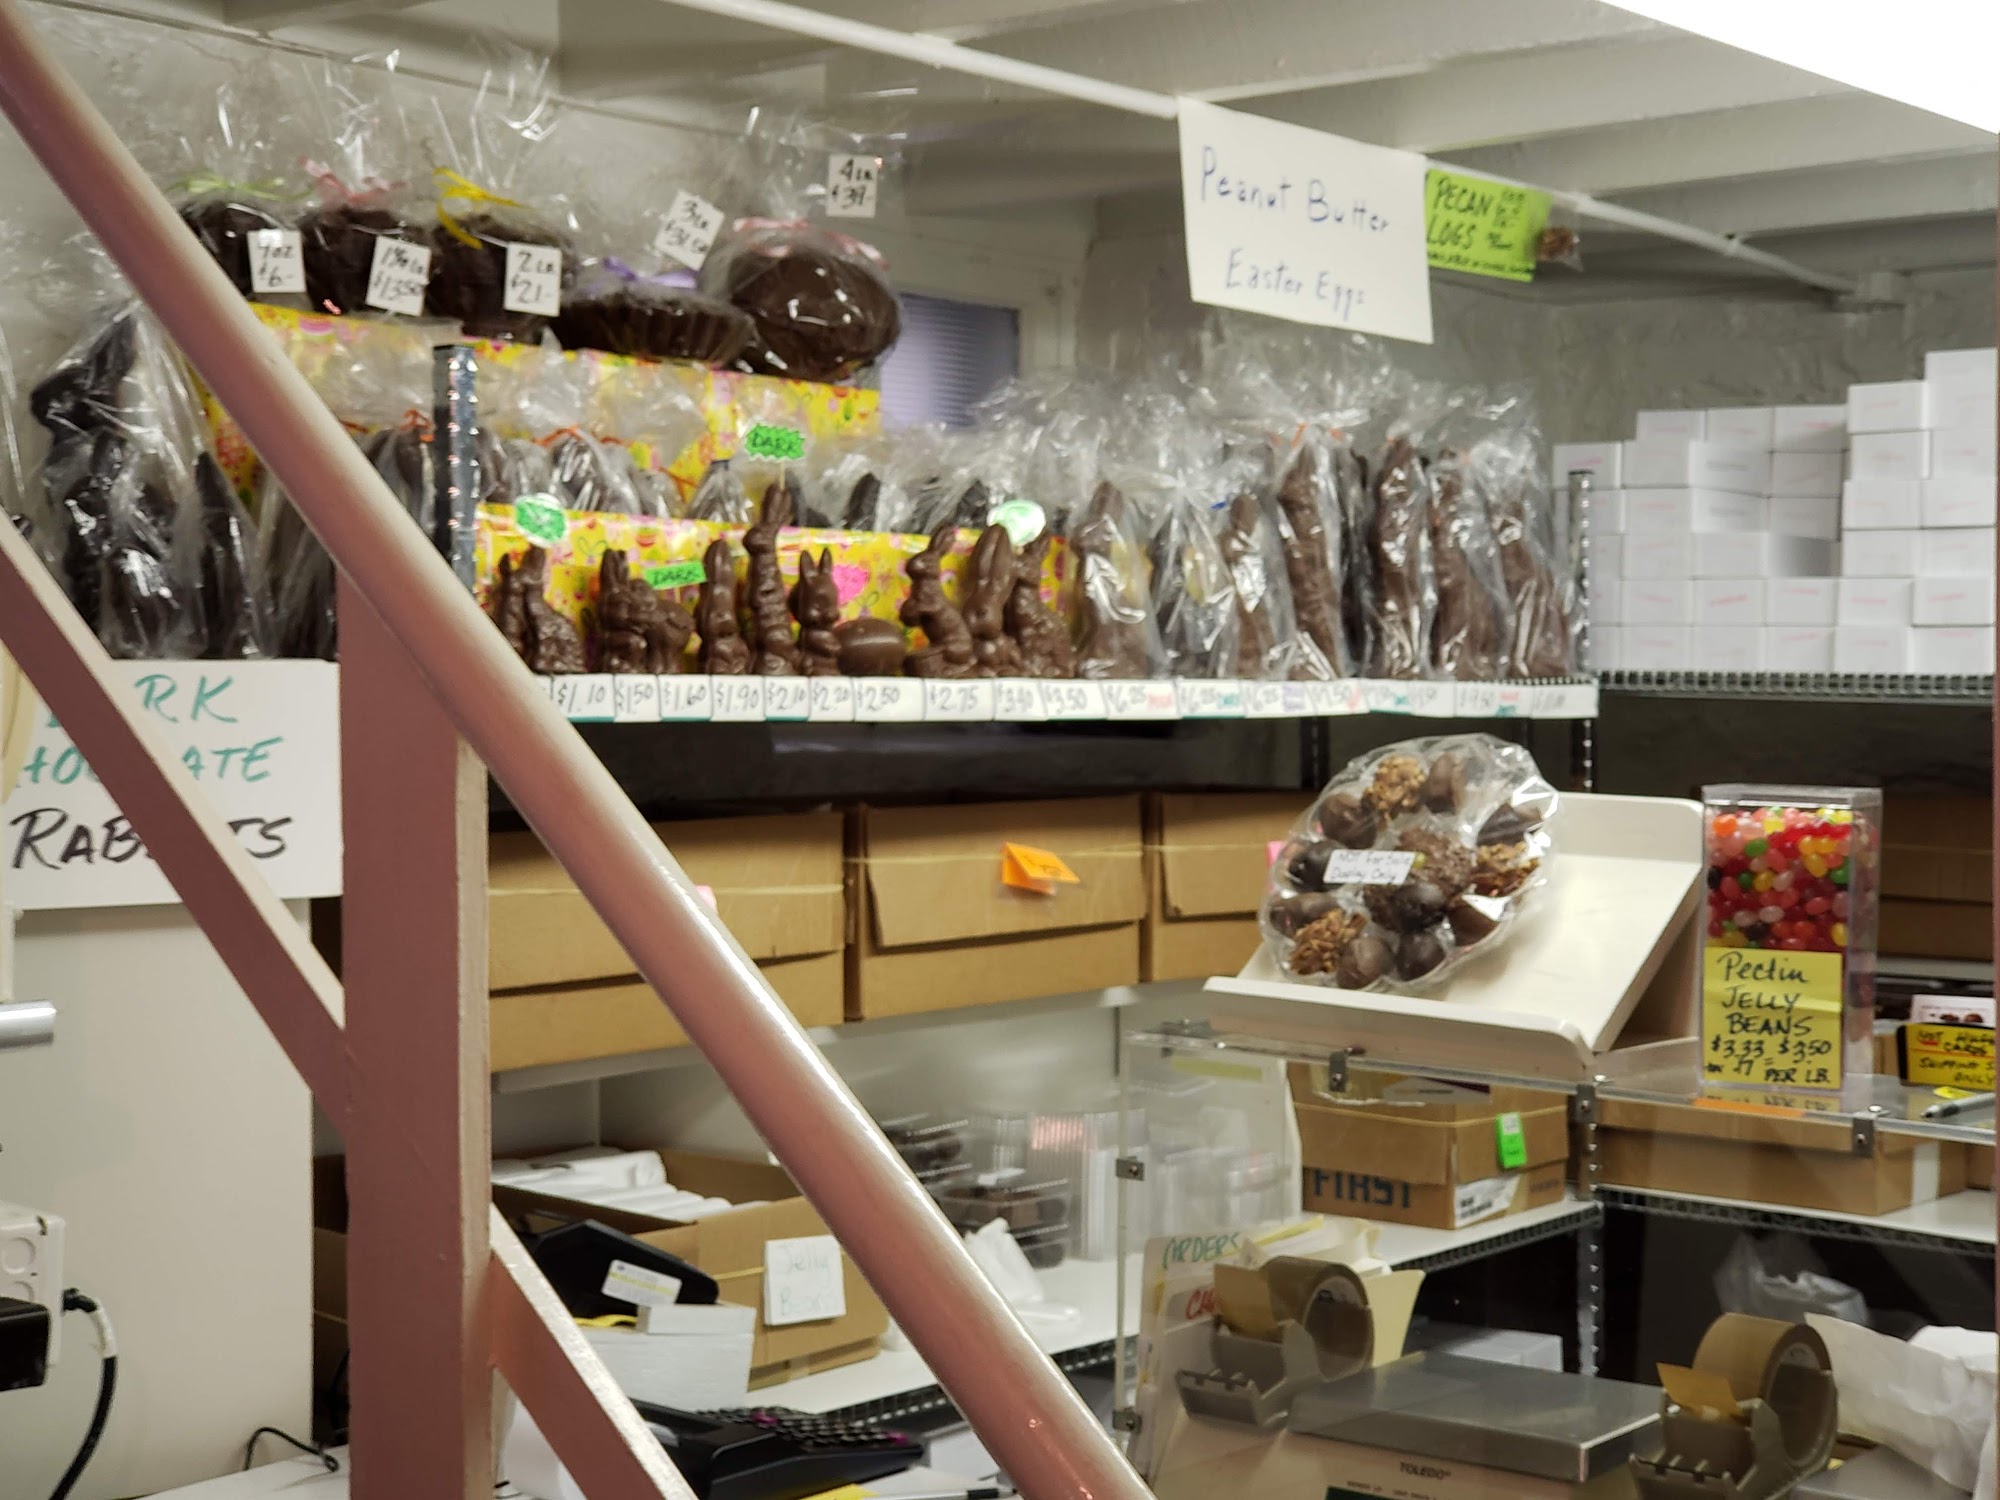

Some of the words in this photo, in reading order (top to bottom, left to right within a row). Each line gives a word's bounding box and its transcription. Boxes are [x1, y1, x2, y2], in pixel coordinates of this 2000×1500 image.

[1200, 144, 1293, 211] Peanut
[1307, 178, 1390, 233] Butter
[1433, 176, 1494, 217] PECAN
[1426, 214, 1477, 250] LOGS
[517, 250, 533, 273] 2
[1224, 246, 1304, 290] Easter
[1314, 271, 1366, 321] Eggs
[1717, 950, 1808, 983] Pectin
[1722, 984, 1800, 1013] JELLY
[1726, 1012, 1814, 1037] BEANS
[1764, 1067, 1798, 1083] PER
[1163, 1232, 1241, 1269] ORDERS
